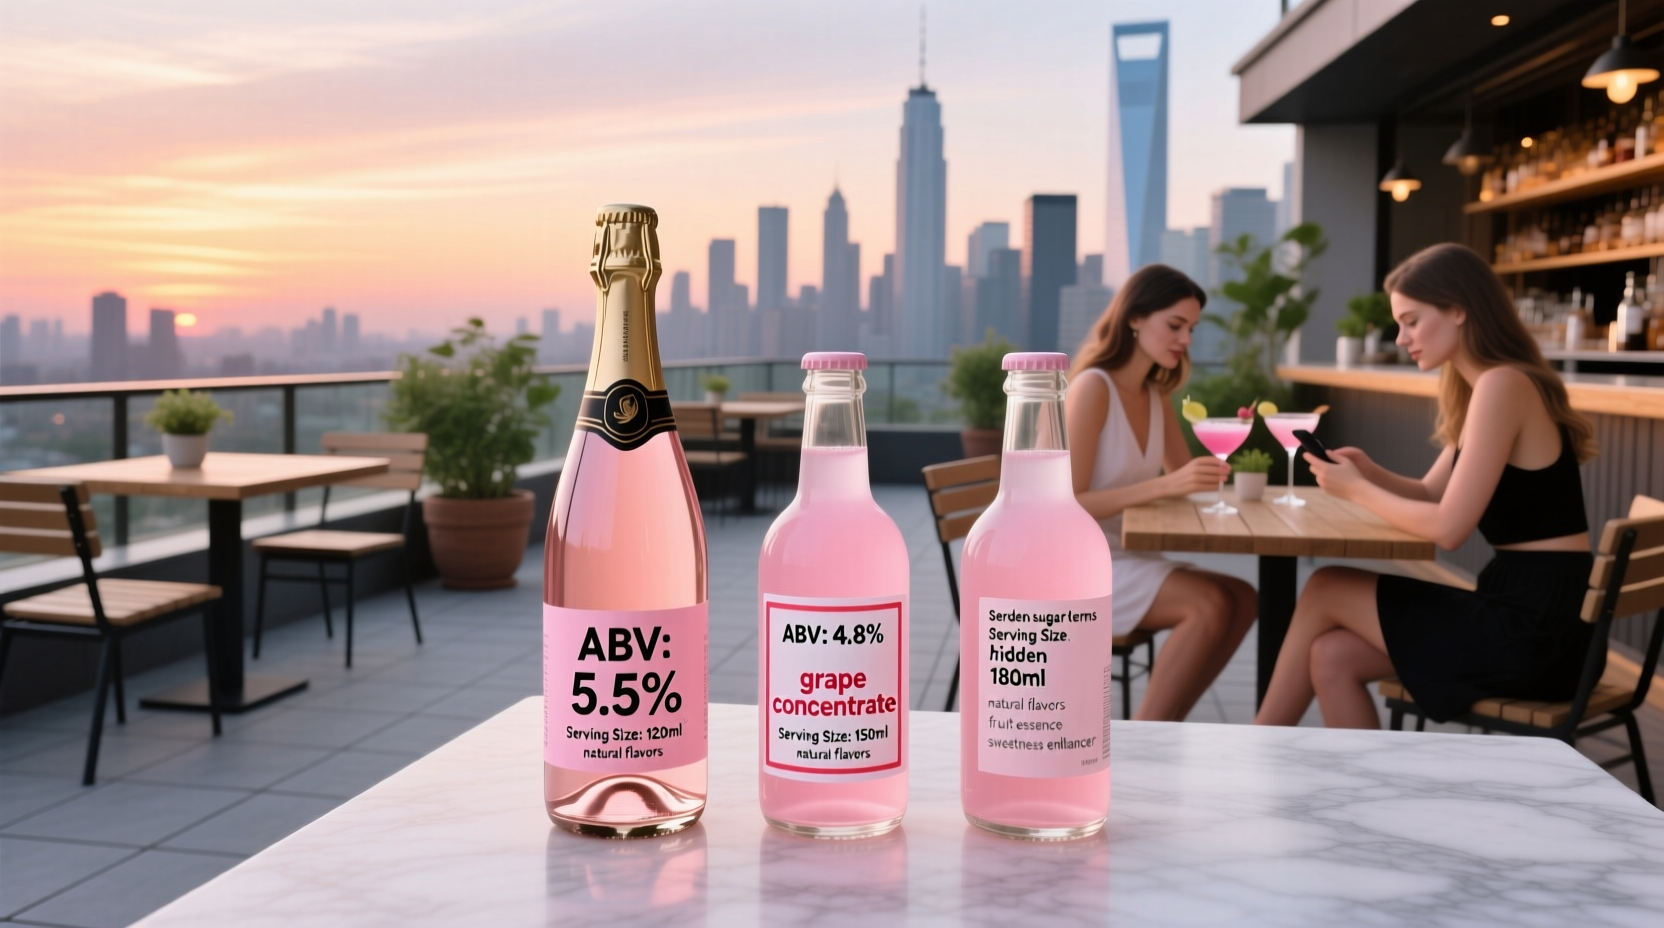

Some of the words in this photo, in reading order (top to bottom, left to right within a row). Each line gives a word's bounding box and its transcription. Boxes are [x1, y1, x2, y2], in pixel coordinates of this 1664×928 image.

[1033, 613, 1066, 627] sugar
[578, 626, 670, 661] ABV:
[782, 624, 827, 644] ABV:
[833, 623, 884, 645] 4.8%
[989, 627, 1036, 645] Serving
[990, 644, 1047, 663] hidden
[800, 672, 866, 695] grape
[990, 667, 1045, 686] 180ml
[571, 670, 682, 716] 5.5%
[773, 694, 896, 716] concentrate
[988, 698, 1023, 710] natural
[1028, 697, 1065, 711] flavors
[989, 715, 1013, 729] fruit
[1016, 721, 1063, 730] essence
[567, 726, 609, 744] Serving
[647, 723, 682, 740] 120ml
[779, 727, 819, 745] Serving
[855, 725, 888, 741] 150ml
[584, 746, 621, 758] natural
[626, 746, 663, 758] flavors
[797, 749, 831, 760] natural
[834, 747, 870, 760] flavors
[988, 738, 1043, 750] sweetness
